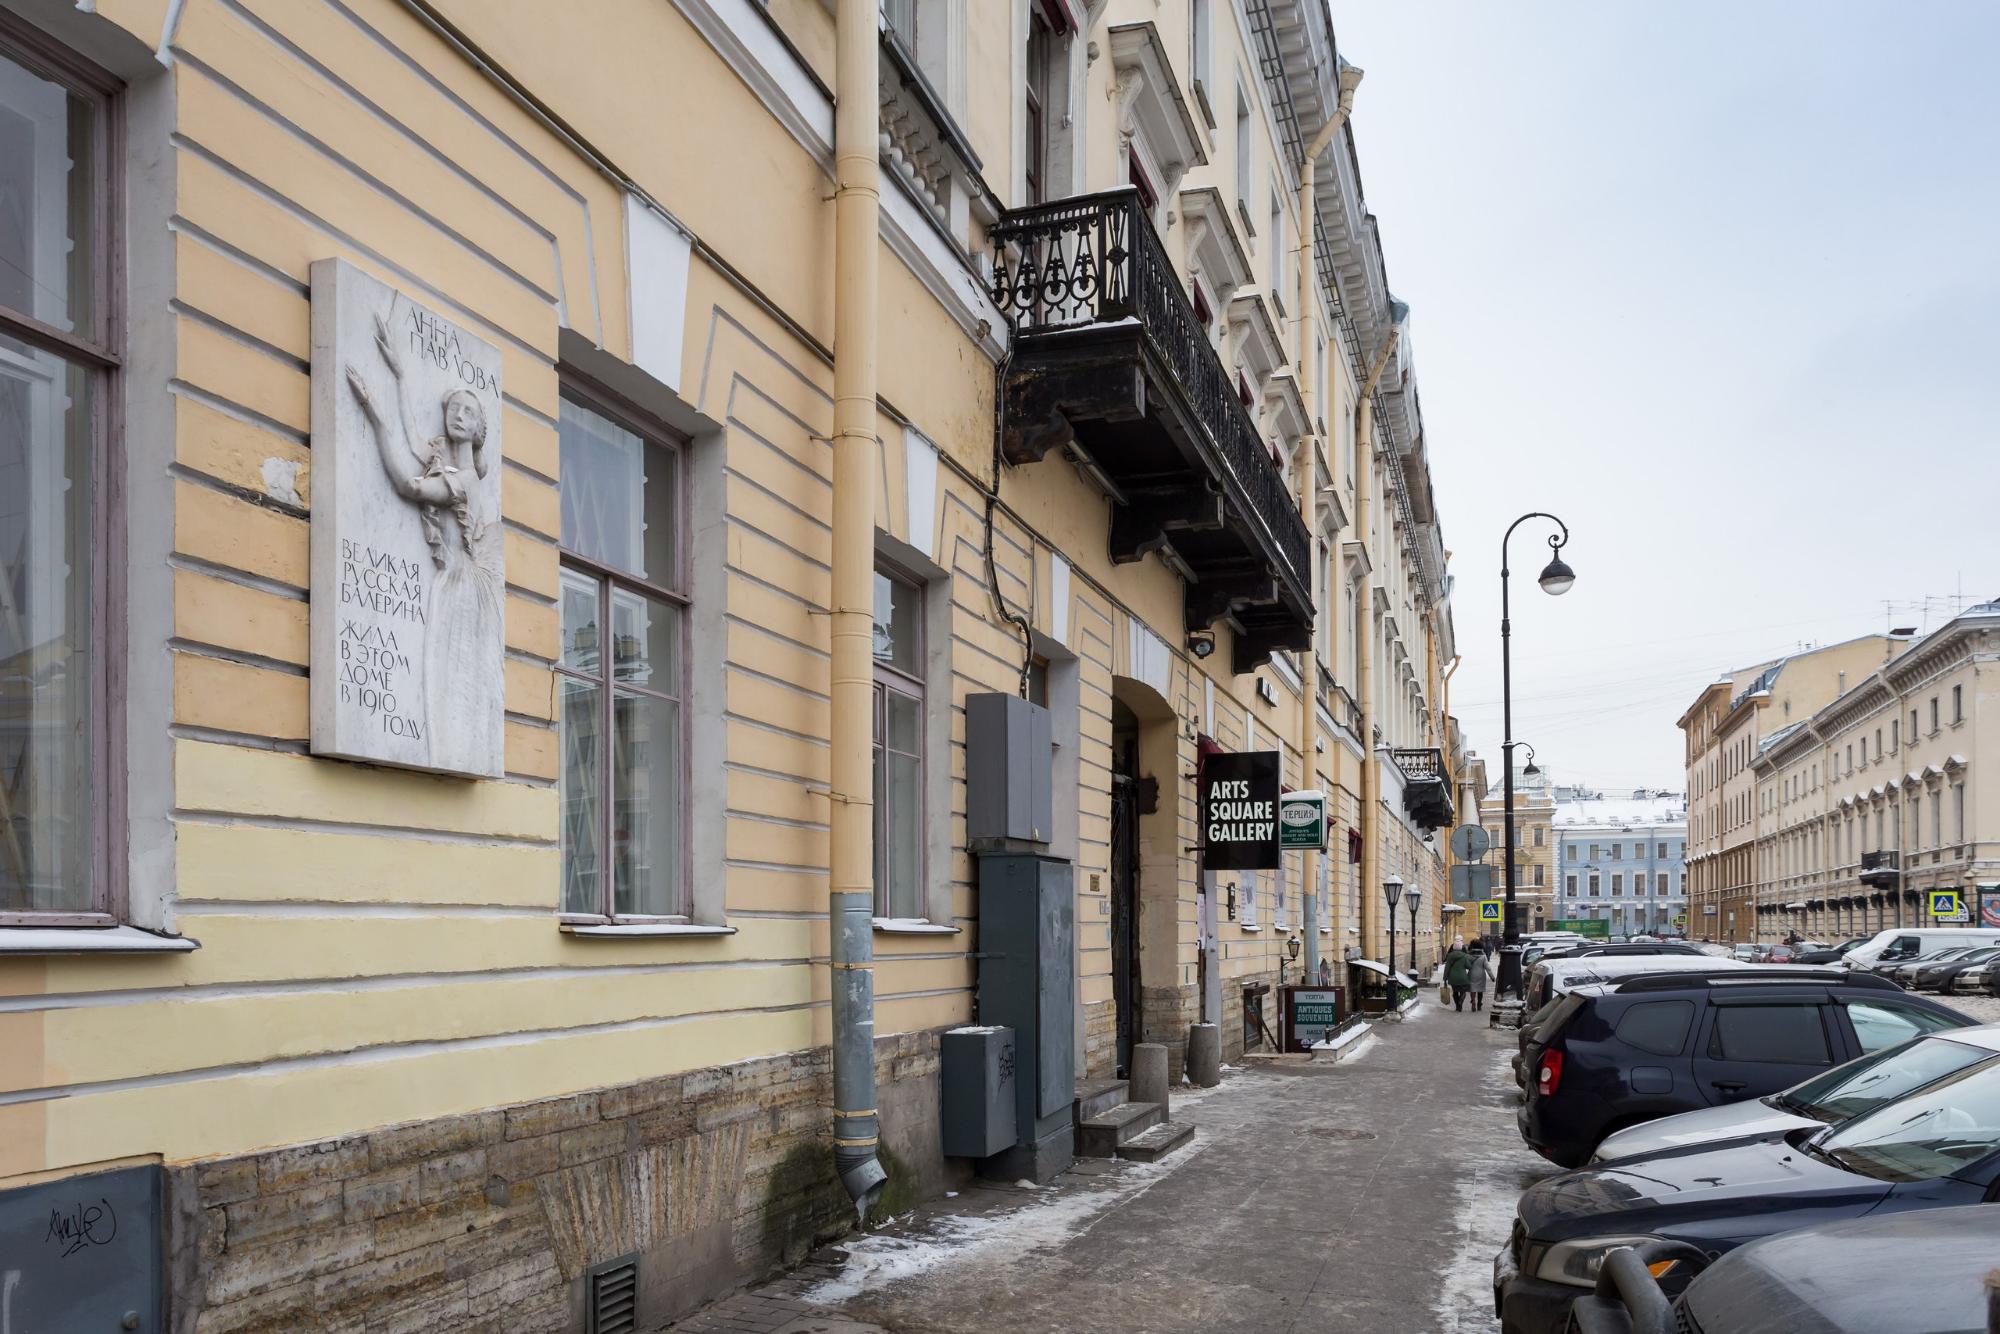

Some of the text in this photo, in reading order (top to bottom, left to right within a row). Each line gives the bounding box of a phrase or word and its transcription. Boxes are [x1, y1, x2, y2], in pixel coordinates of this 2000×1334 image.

[404, 306, 461, 356] АННА
[410, 331, 498, 399] ПАВЛОВА
[342, 538, 419, 582] ВЕЛИКАЯ
[342, 561, 422, 604] РУССКАЯ
[342, 582, 425, 625] БАЛЕРИНА
[339, 618, 398, 650] ЖИЛА
[340, 639, 411, 675] В ЭТОМ
[339, 661, 394, 692] ДОМЕ
[340, 683, 397, 716] В 1910
[383, 714, 426, 741] ГОДУ
[1210, 780, 1249, 800] ARTS
[1210, 801, 1273, 821] SQUARE
[1283, 810, 1314, 819] ТЕРЦИЯ
[1208, 822, 1274, 842] GALLERY
[1296, 1013, 1333, 1022] SOUVENIRS
[1297, 1005, 1332, 1014] ANTIQUES
